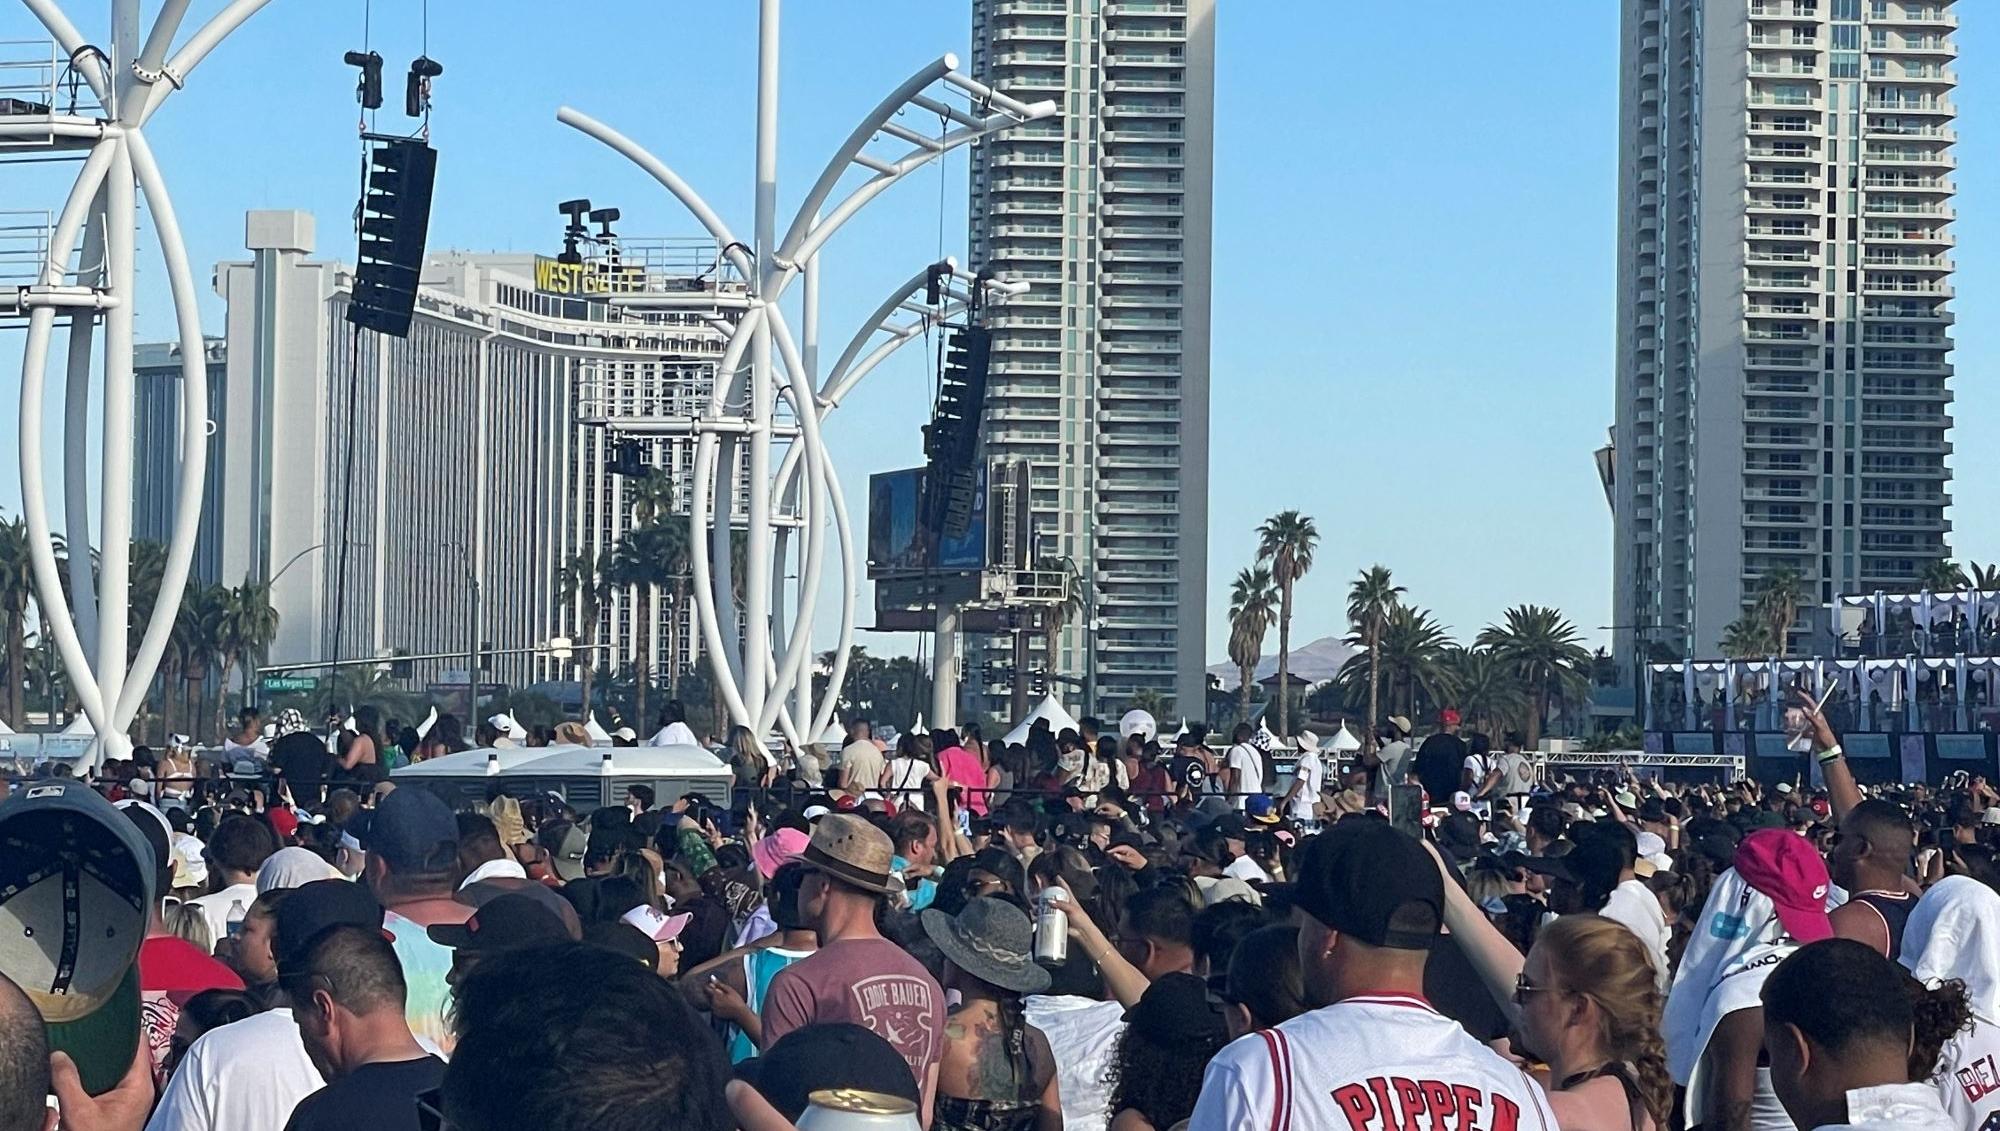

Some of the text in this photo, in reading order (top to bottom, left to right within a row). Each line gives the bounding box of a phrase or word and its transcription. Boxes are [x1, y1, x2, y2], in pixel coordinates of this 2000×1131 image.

[282, 679, 303, 690] Vegas
[863, 983, 928, 1011] EDDIE BAUER
[1331, 1076, 1520, 1131] PIPPEN
